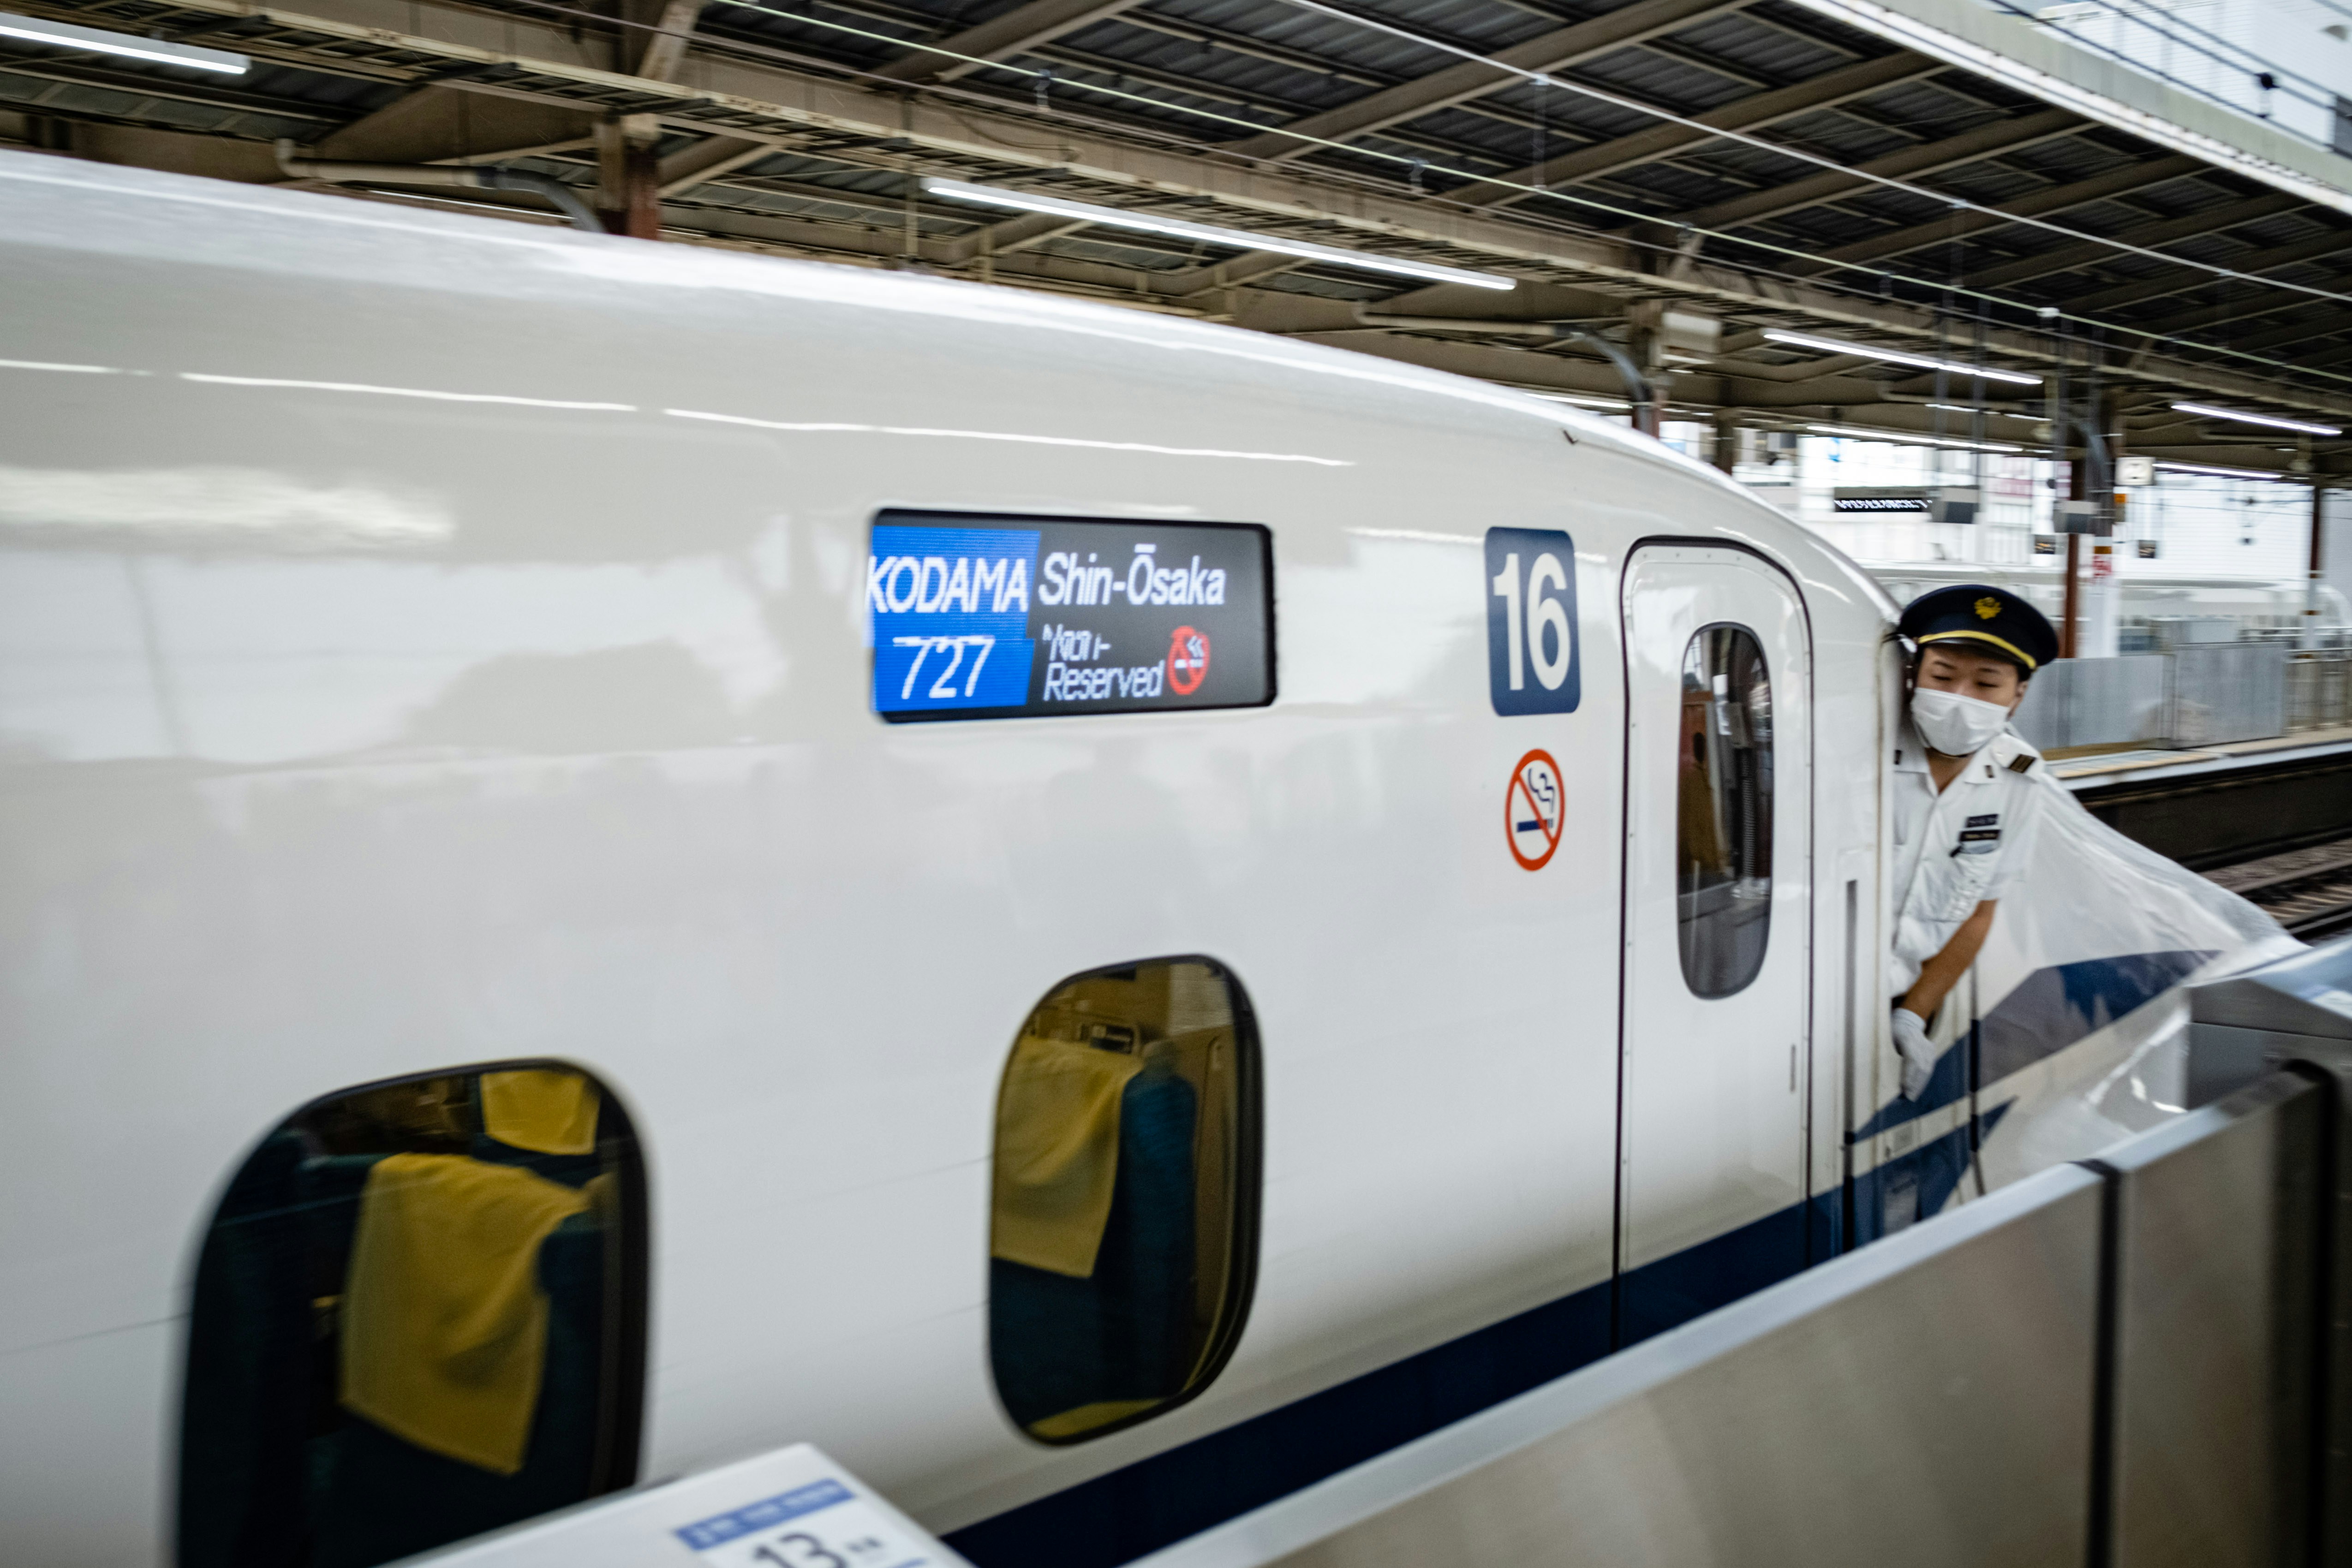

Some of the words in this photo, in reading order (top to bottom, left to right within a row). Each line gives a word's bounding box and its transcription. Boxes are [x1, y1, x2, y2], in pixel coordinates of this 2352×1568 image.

[866, 555, 1028, 614] KODAMA
[1039, 544, 1226, 606] Shin-Ōsaka
[1492, 552, 1571, 691] 16
[893, 635, 996, 700] 727
[1043, 660, 1166, 701] Reserved
